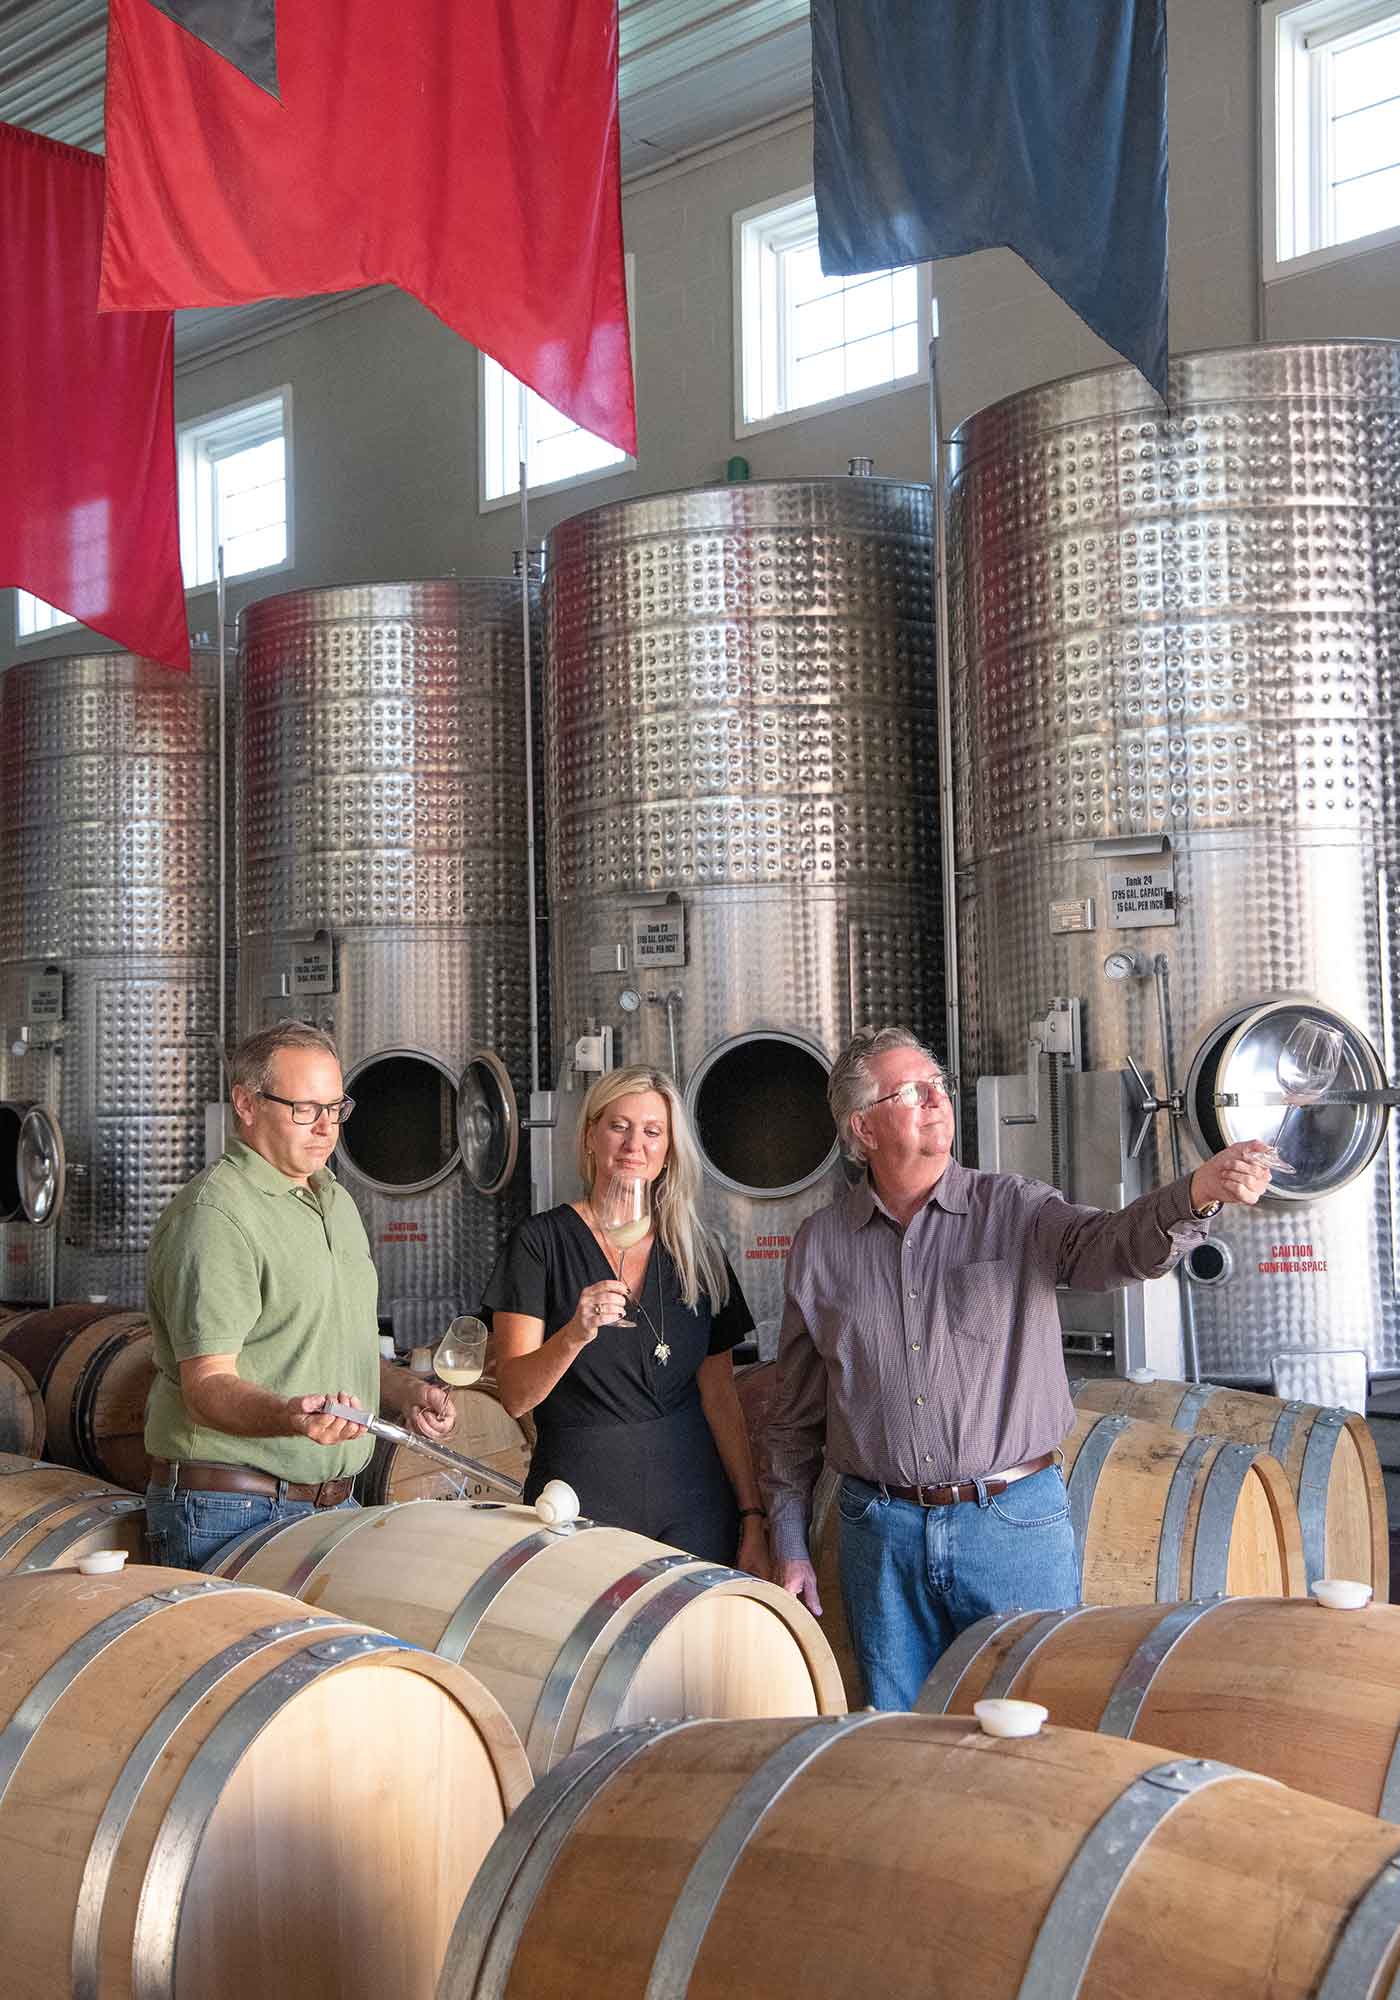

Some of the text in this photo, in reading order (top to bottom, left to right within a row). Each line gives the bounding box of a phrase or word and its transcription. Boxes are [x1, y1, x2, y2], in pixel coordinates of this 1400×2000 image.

[1125, 875, 1152, 886] Tank 24
[1112, 889, 1125, 900] 1795
[1127, 888, 1139, 899] GAL.
[1117, 900, 1164, 912] 15 GAL. PER INCH
[756, 1235, 791, 1248] CAUTION
[1271, 1244, 1313, 1258] CAUTION
[1258, 1261, 1328, 1273] CONFINED SPACE
